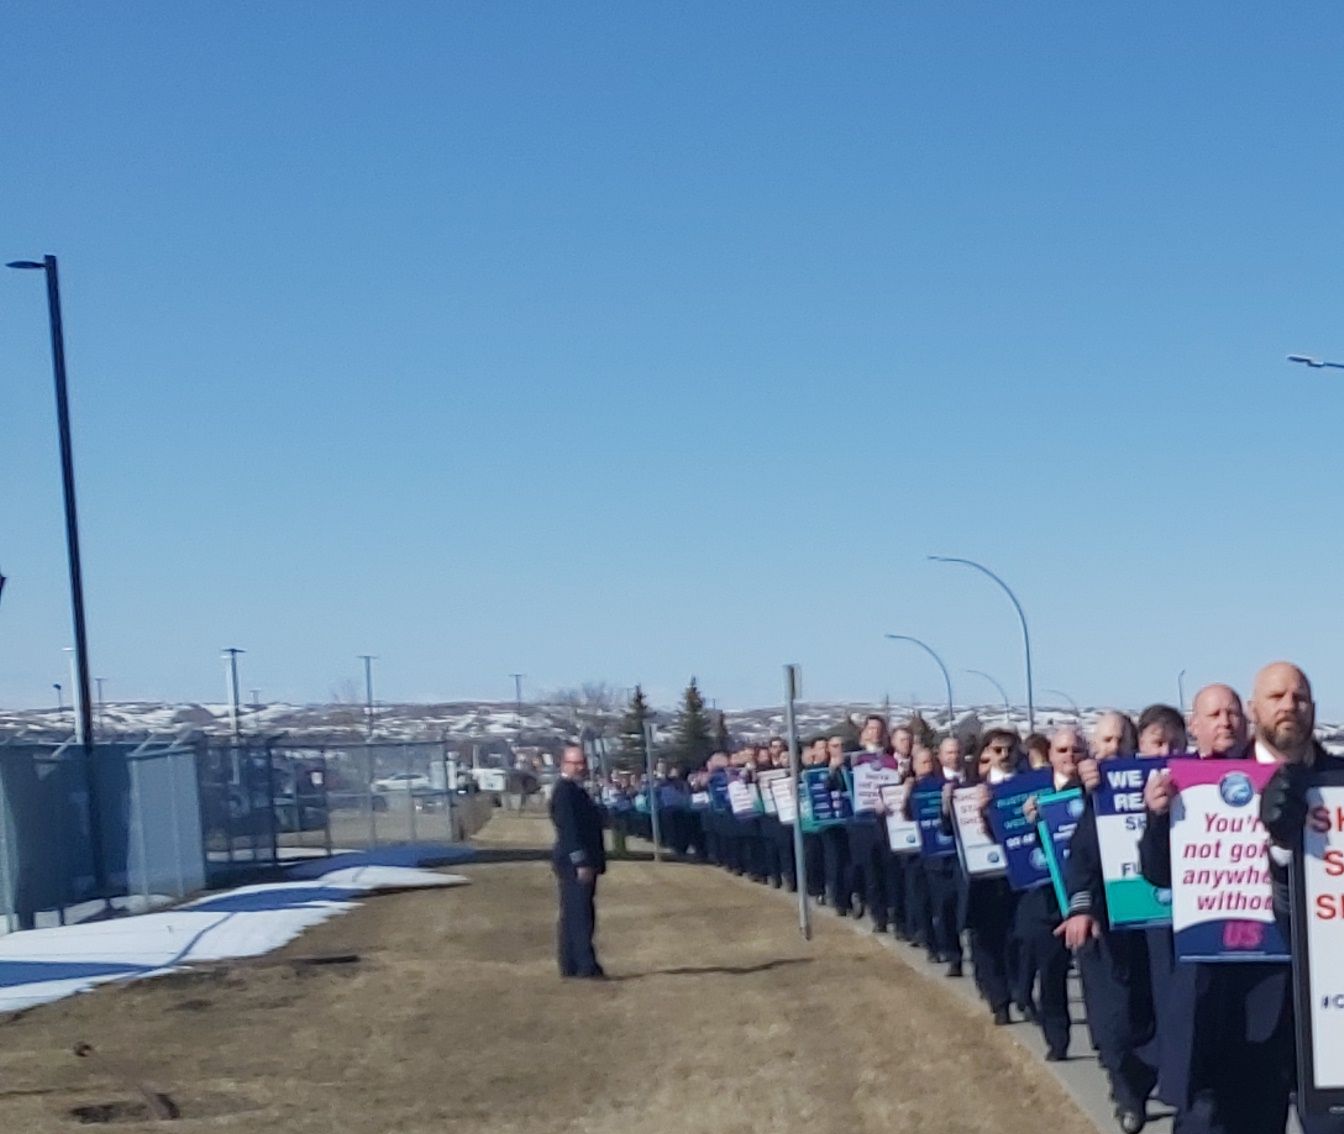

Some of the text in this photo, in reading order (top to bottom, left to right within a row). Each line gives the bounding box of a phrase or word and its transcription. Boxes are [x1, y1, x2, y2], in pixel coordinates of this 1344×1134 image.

[1107, 769, 1144, 788] WE
[1114, 792, 1146, 812] RE
[1205, 813, 1268, 833] You'r
[1183, 839, 1221, 859] not
[1182, 866, 1272, 889] anywhe
[1197, 890, 1273, 911] withou
[1223, 921, 1262, 949] US
